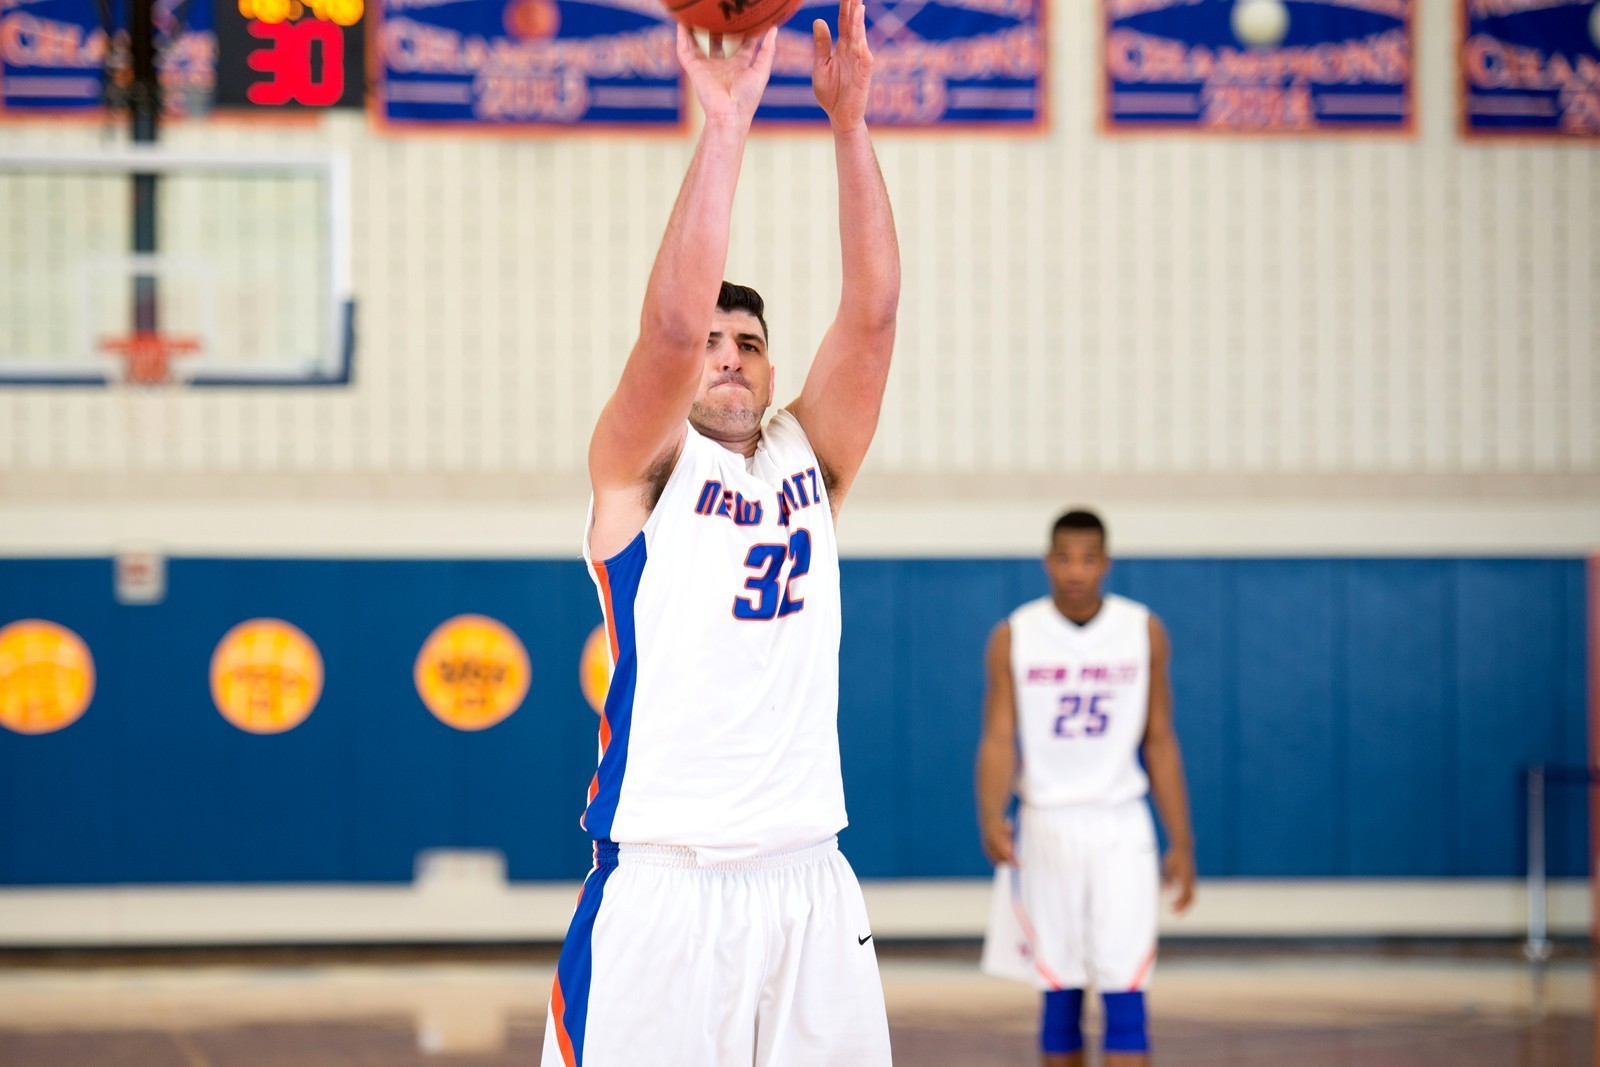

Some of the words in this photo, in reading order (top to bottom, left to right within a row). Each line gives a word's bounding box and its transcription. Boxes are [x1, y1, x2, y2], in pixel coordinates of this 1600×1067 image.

[246, 18, 344, 106] 30
[694, 479, 764, 526] NEW
[731, 527, 812, 621] 32
[1052, 693, 1112, 738] 25
